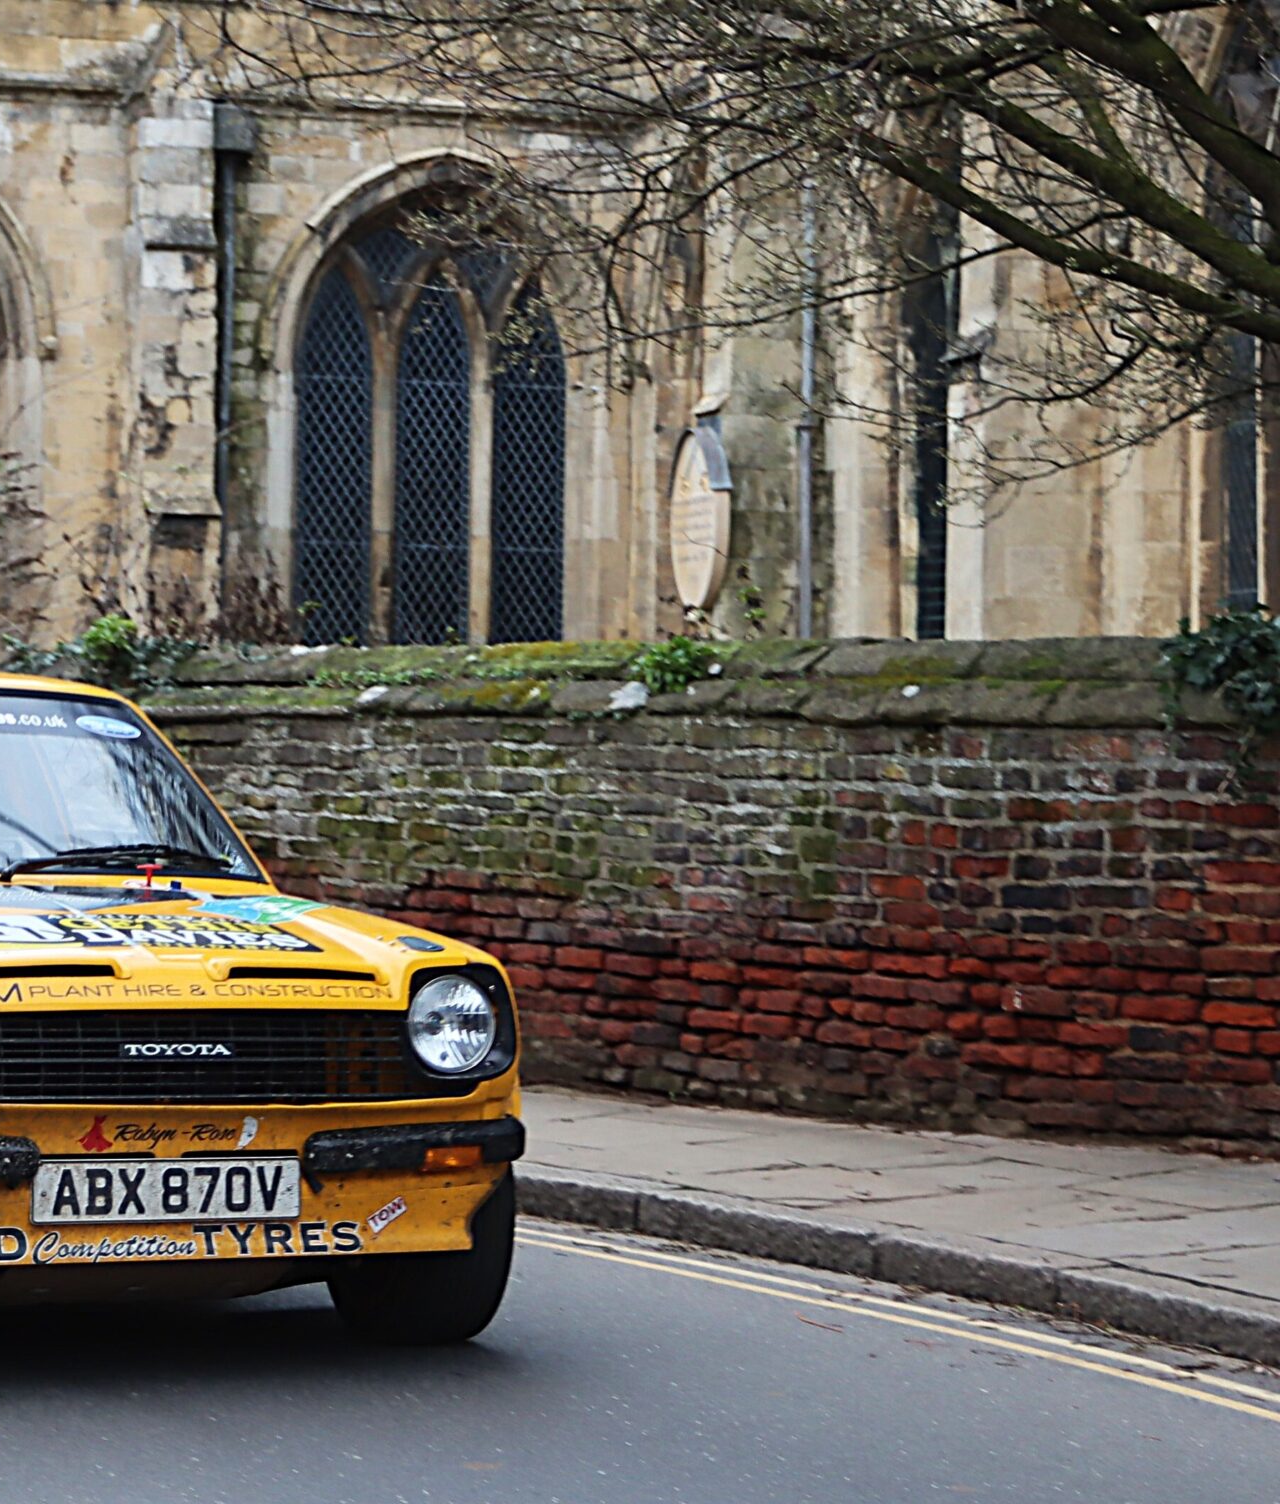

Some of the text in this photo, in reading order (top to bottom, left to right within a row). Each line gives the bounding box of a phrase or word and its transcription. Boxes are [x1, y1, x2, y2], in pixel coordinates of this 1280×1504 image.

[71, 929, 310, 948] DAVIES
[29, 984, 116, 999] PLANT
[123, 983, 184, 998] HIRE
[189, 983, 208, 997] &
[213, 983, 394, 1000] CONSTRUCTION
[124, 1042, 232, 1057] TOYOTA
[52, 1164, 283, 1216] ABX 870V
[368, 1198, 403, 1227] TOW
[32, 1231, 196, 1265] Competition
[193, 1220, 362, 1257] TYRES
